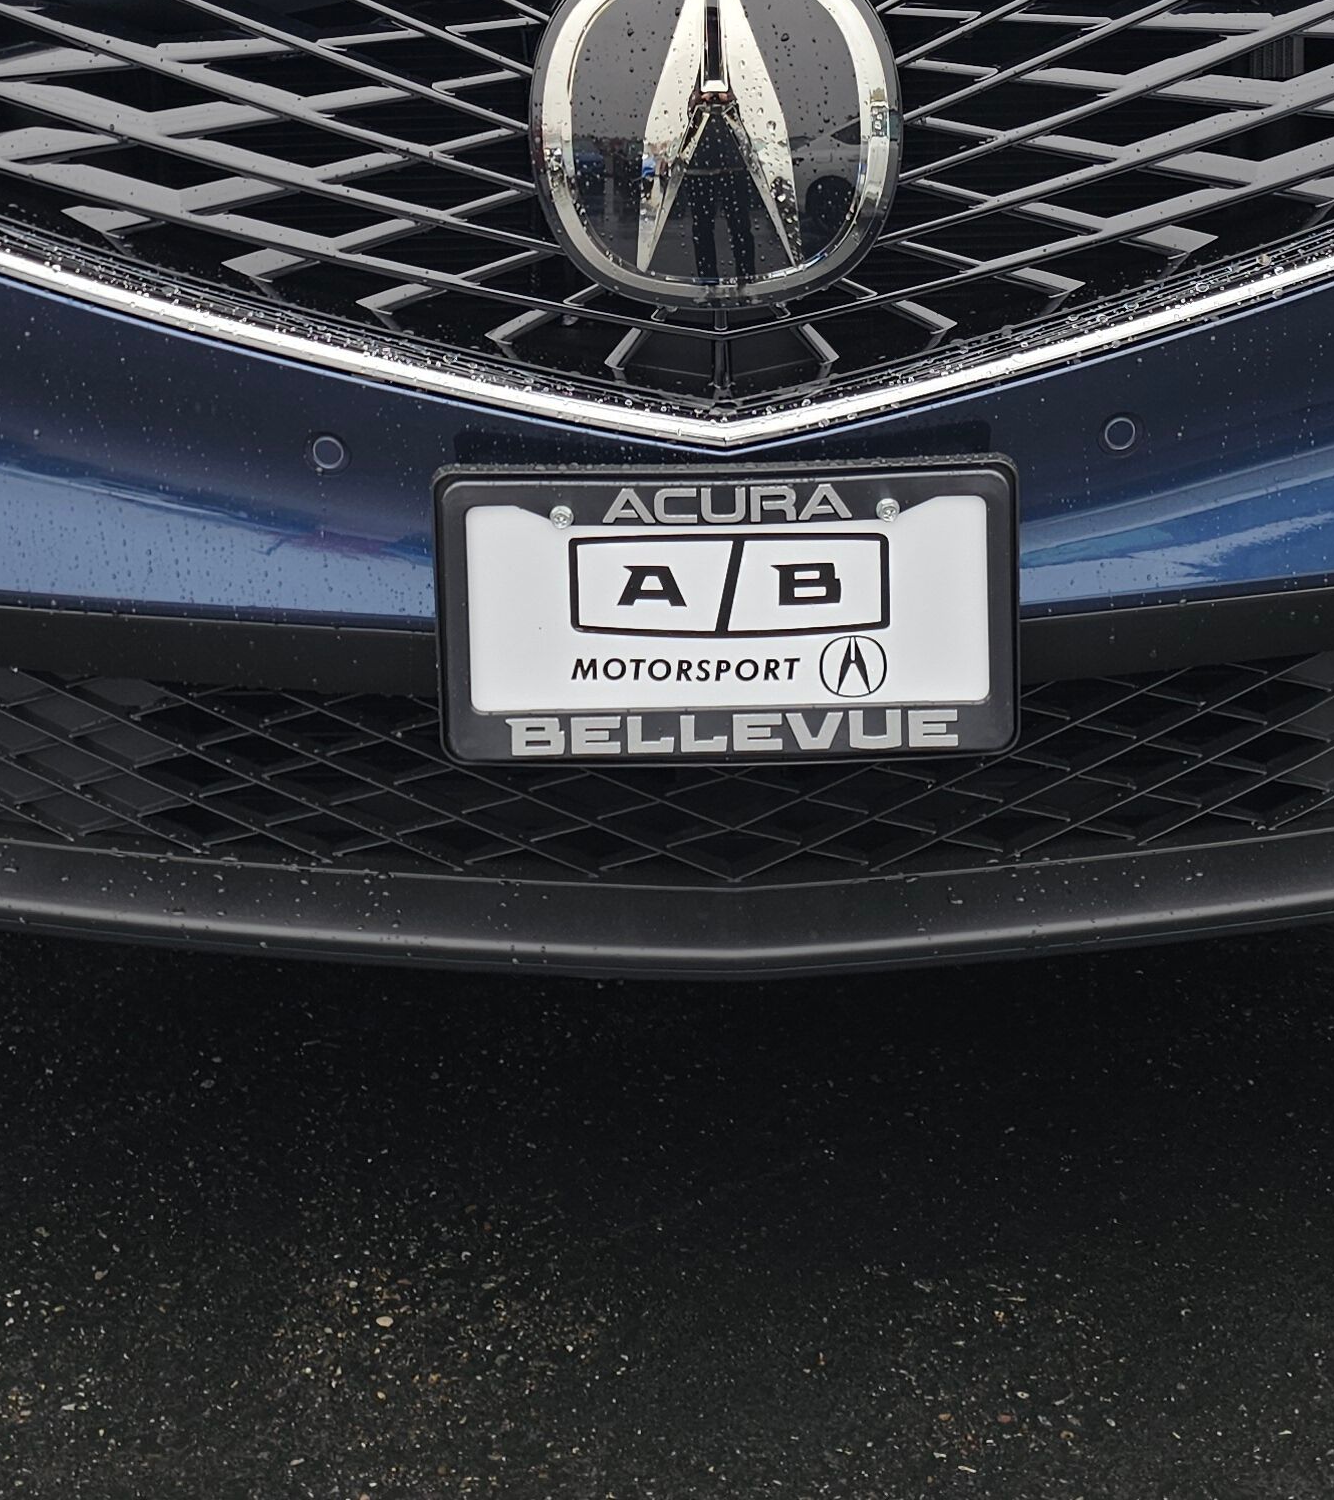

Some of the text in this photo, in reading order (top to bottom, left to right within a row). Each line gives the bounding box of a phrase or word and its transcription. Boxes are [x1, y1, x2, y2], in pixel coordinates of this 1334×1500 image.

[602, 483, 853, 525] ACURA
[617, 562, 842, 607] A B
[571, 657, 801, 683] MOTORSPORT
[505, 709, 959, 757] BELLEVUE
